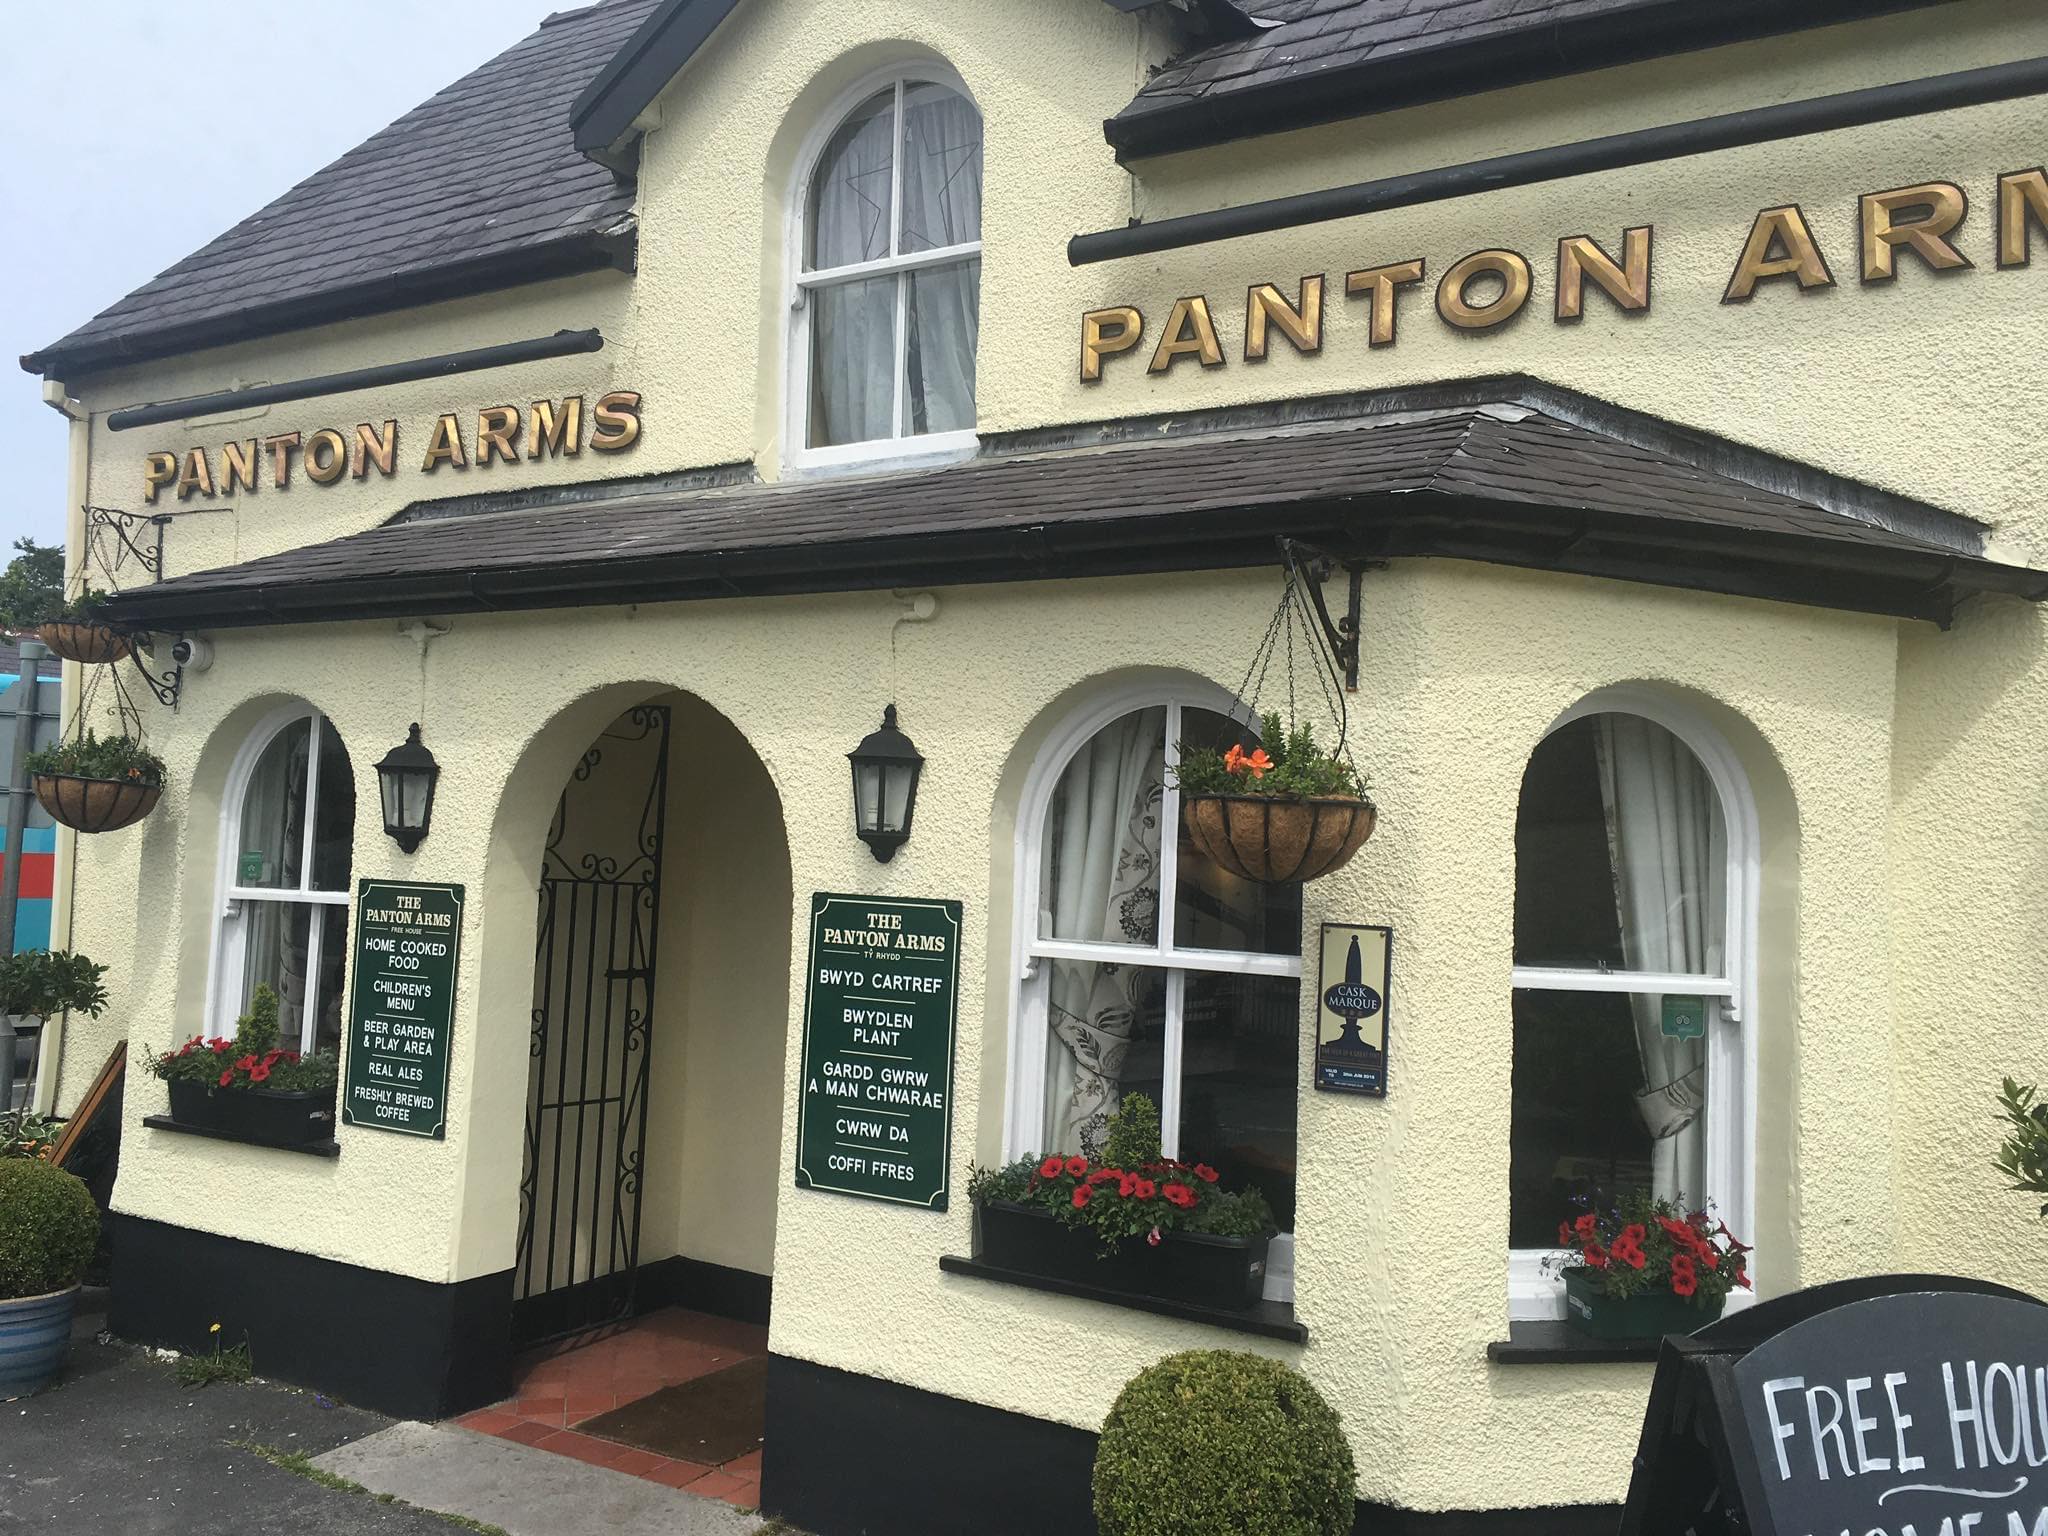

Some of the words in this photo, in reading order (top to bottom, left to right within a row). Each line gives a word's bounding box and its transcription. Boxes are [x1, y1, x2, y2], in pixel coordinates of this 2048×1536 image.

[1080, 224, 1653, 383] PANTON
[144, 419, 398, 503] PANTON
[421, 391, 642, 472] ARMS
[396, 895, 422, 910] THE
[366, 909, 412, 925] PANTON
[415, 913, 451, 927] ARMS
[867, 913, 902, 930] THE
[390, 926, 403, 934] FREE
[404, 928, 422, 936] HOUSE
[823, 928, 890, 947] PANTON
[894, 934, 946, 952] ARMS
[365, 937, 396, 952] HOME
[400, 940, 447, 957] COOKED
[875, 951, 901, 961] RHYDD
[388, 955, 420, 970] FOOD
[373, 980, 432, 998] CHILDREN'S
[819, 969, 865, 988] BWYD
[871, 973, 943, 994] CARTREF
[1337, 986, 1367, 998] CASK
[386, 996, 415, 1011] MENU
[1329, 997, 1377, 1010] MARQUE
[843, 1009, 913, 1029] BWYDLEN
[363, 1020, 389, 1034] BEER
[393, 1024, 435, 1041] GARDEN
[853, 1028, 900, 1046] PLANT
[363, 1035, 370, 1048] &
[374, 1036, 400, 1052] PLAY
[403, 1041, 433, 1056] AREA
[368, 1062, 394, 1078] REAL
[397, 1066, 424, 1082] ALES
[823, 1061, 874, 1081] GARDD
[880, 1068, 929, 1087] GWRW
[354, 1086, 392, 1104] FRESHLY
[395, 1092, 434, 1109] BREWED
[808, 1078, 819, 1094] A
[826, 1081, 859, 1099] MAN
[866, 1086, 943, 1109] CHWARAE
[375, 1104, 410, 1122] COFFEE
[836, 1119, 883, 1138] CWRW
[889, 1125, 910, 1143] DA
[828, 1155, 866, 1174] COFFI
[872, 1161, 915, 1181] FFRES
[1762, 1371, 1926, 1481] FREE
